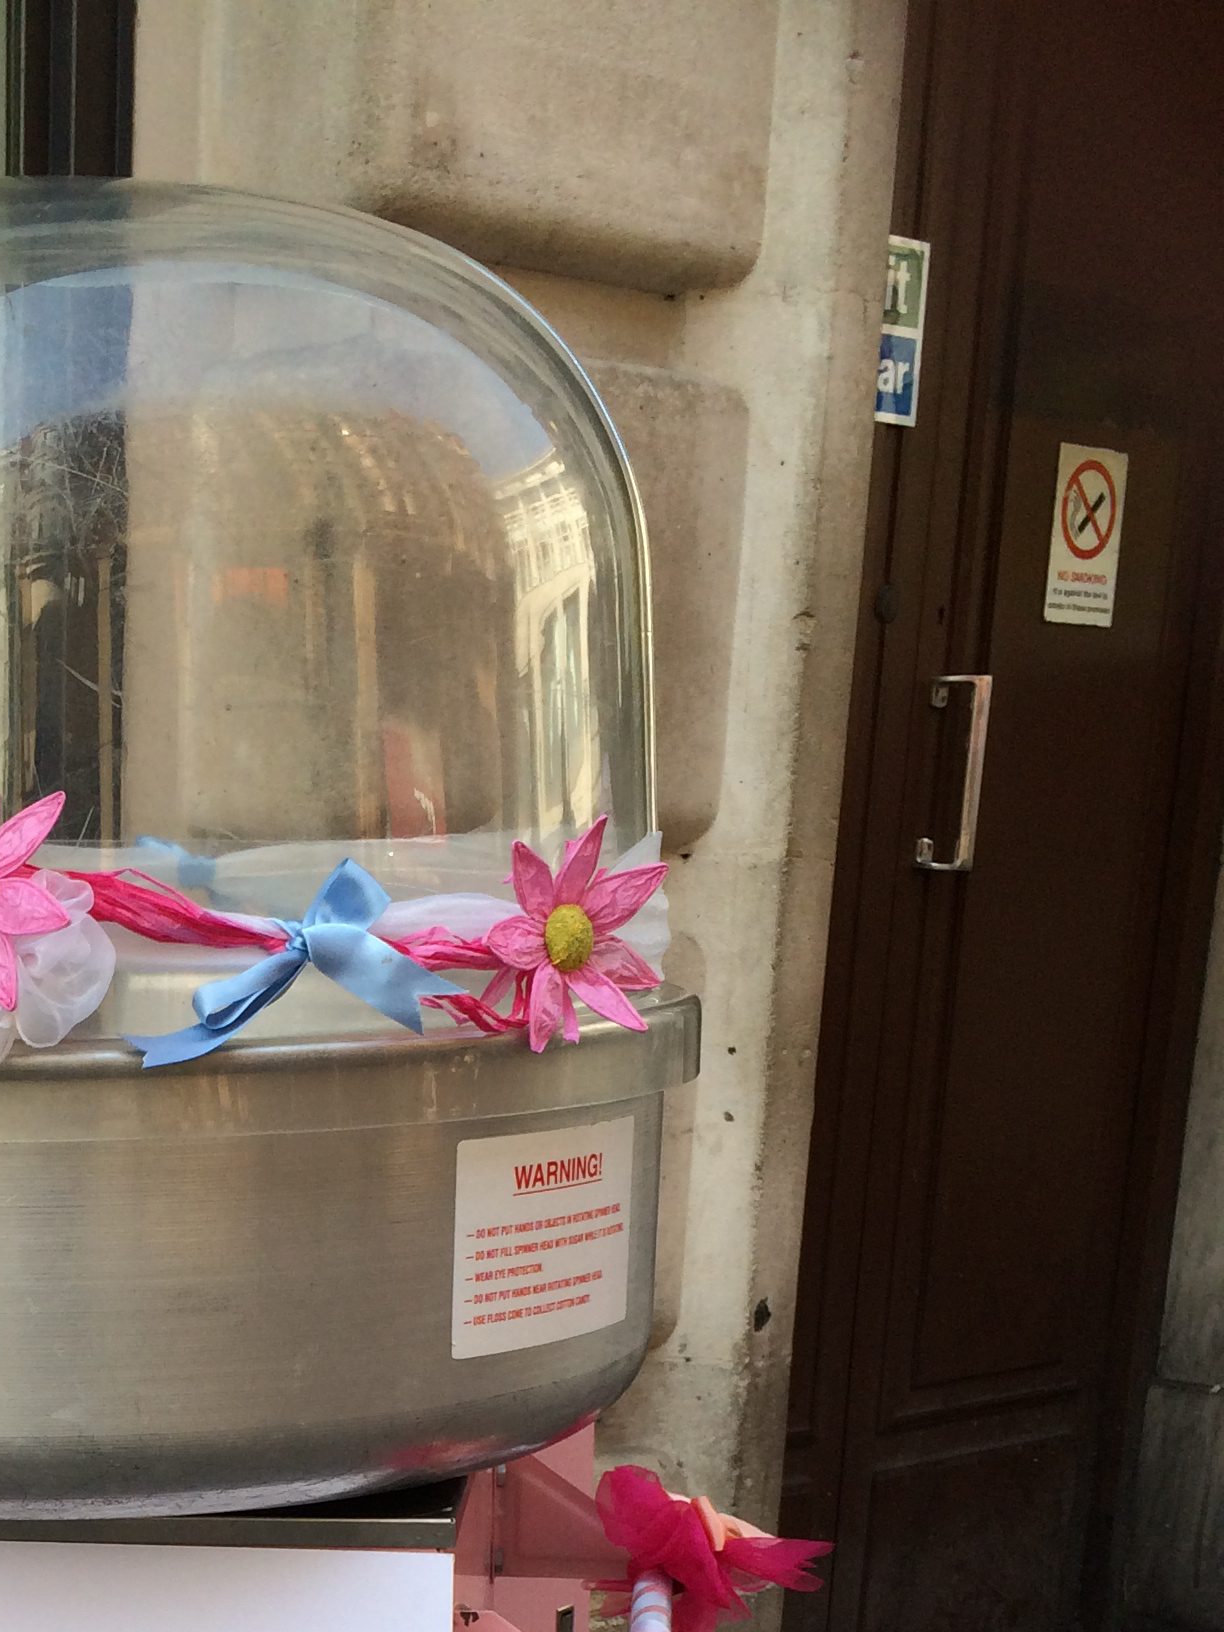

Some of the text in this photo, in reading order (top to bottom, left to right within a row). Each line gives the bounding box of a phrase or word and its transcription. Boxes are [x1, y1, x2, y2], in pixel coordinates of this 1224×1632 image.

[1057, 570, 1107, 585] NO SMOKING
[514, 1152, 603, 1190] WARNING!
[476, 1228, 485, 1238] DO
[487, 1226, 499, 1237] NOT
[501, 1224, 512, 1236] PUT
[514, 1221, 534, 1233] HANDS
[544, 1216, 566, 1228] OBJECTS
[475, 1250, 484, 1261] DO
[486, 1248, 498, 1259] NOT
[501, 1246, 512, 1257] FILL
[514, 1242, 538, 1255] SPINNER
[539, 1239, 553, 1251] HEAD
[475, 1271, 493, 1282] WEAR
[494, 1269, 506, 1280] EYE
[474, 1294, 483, 1304] DO
[485, 1291, 497, 1302] NOT
[499, 1289, 511, 1301] PUT
[511, 1286, 531, 1298] HANDS
[532, 1283, 547, 1295] NEAR
[547, 1277, 572, 1291] ROTATING
[473, 1315, 485, 1326] USE
[487, 1312, 506, 1323] FLOSS
[524, 1306, 532, 1317] TO
[532, 1302, 556, 1316] COLLECT
[556, 1298, 575, 1310] COTTON
